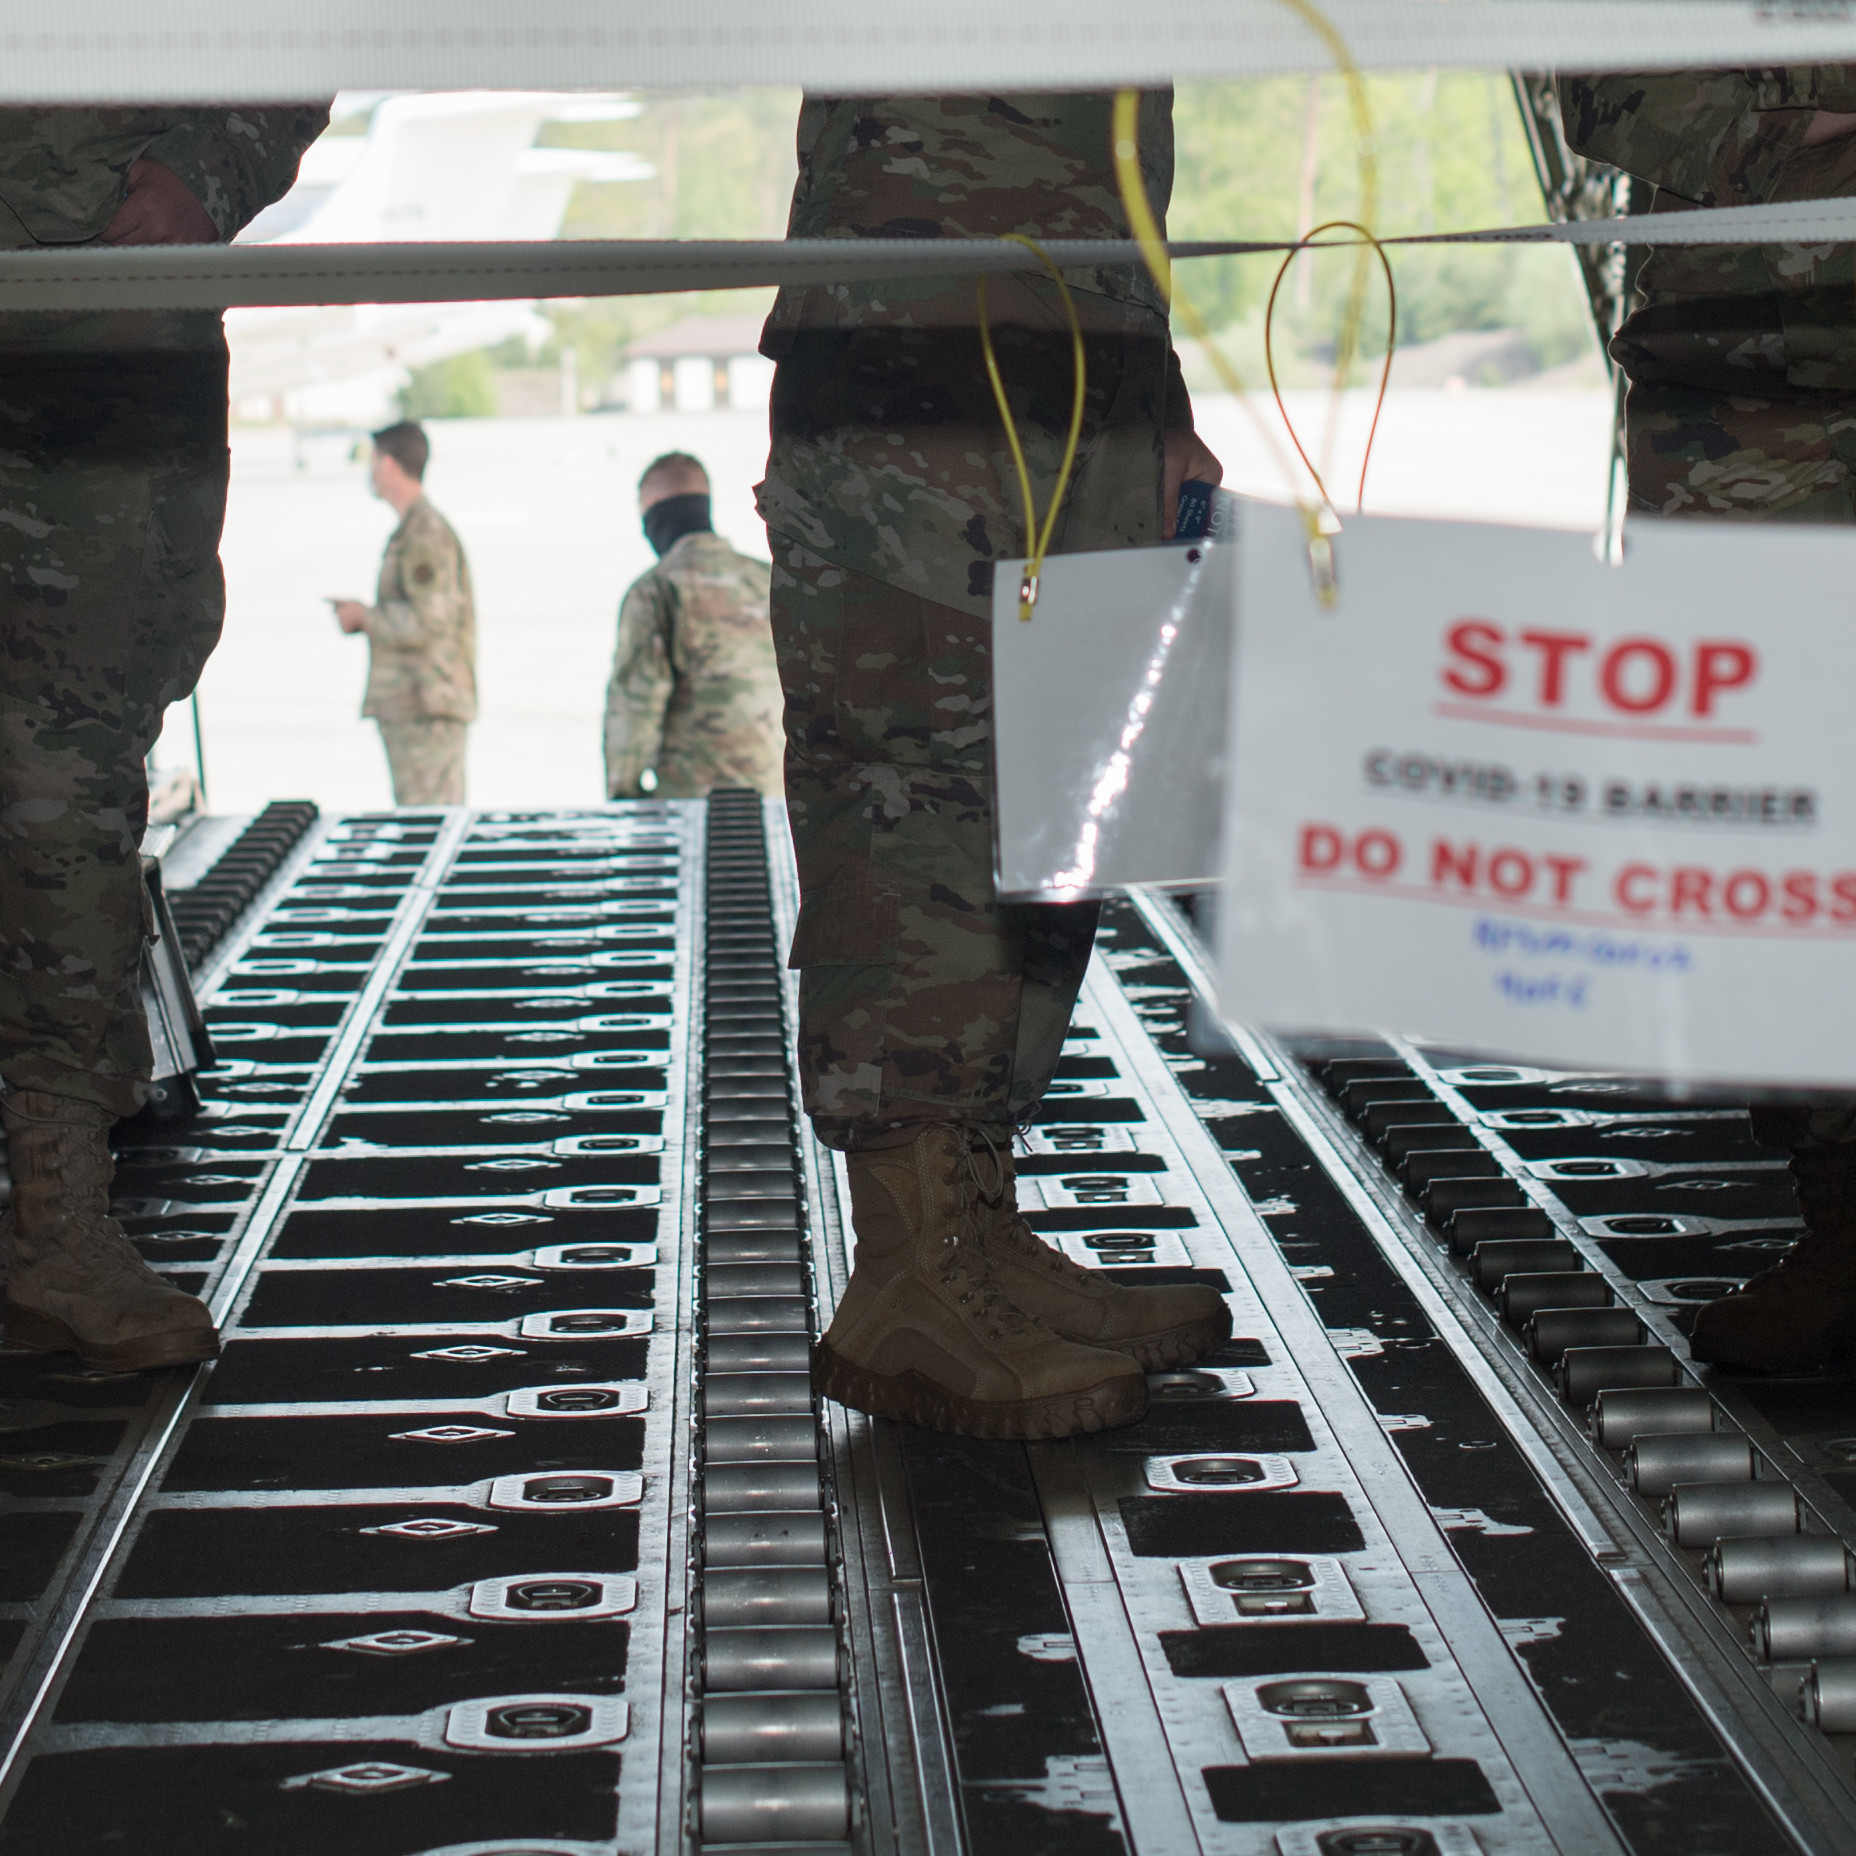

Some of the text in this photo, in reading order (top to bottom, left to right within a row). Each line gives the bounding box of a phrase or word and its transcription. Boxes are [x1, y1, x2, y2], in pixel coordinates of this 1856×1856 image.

[1440, 621, 1759, 720] STOP
[1365, 746, 1817, 825] COVID-19 BARRIER
[1298, 825, 1402, 881] DO
[1430, 838, 1587, 906] NOT
